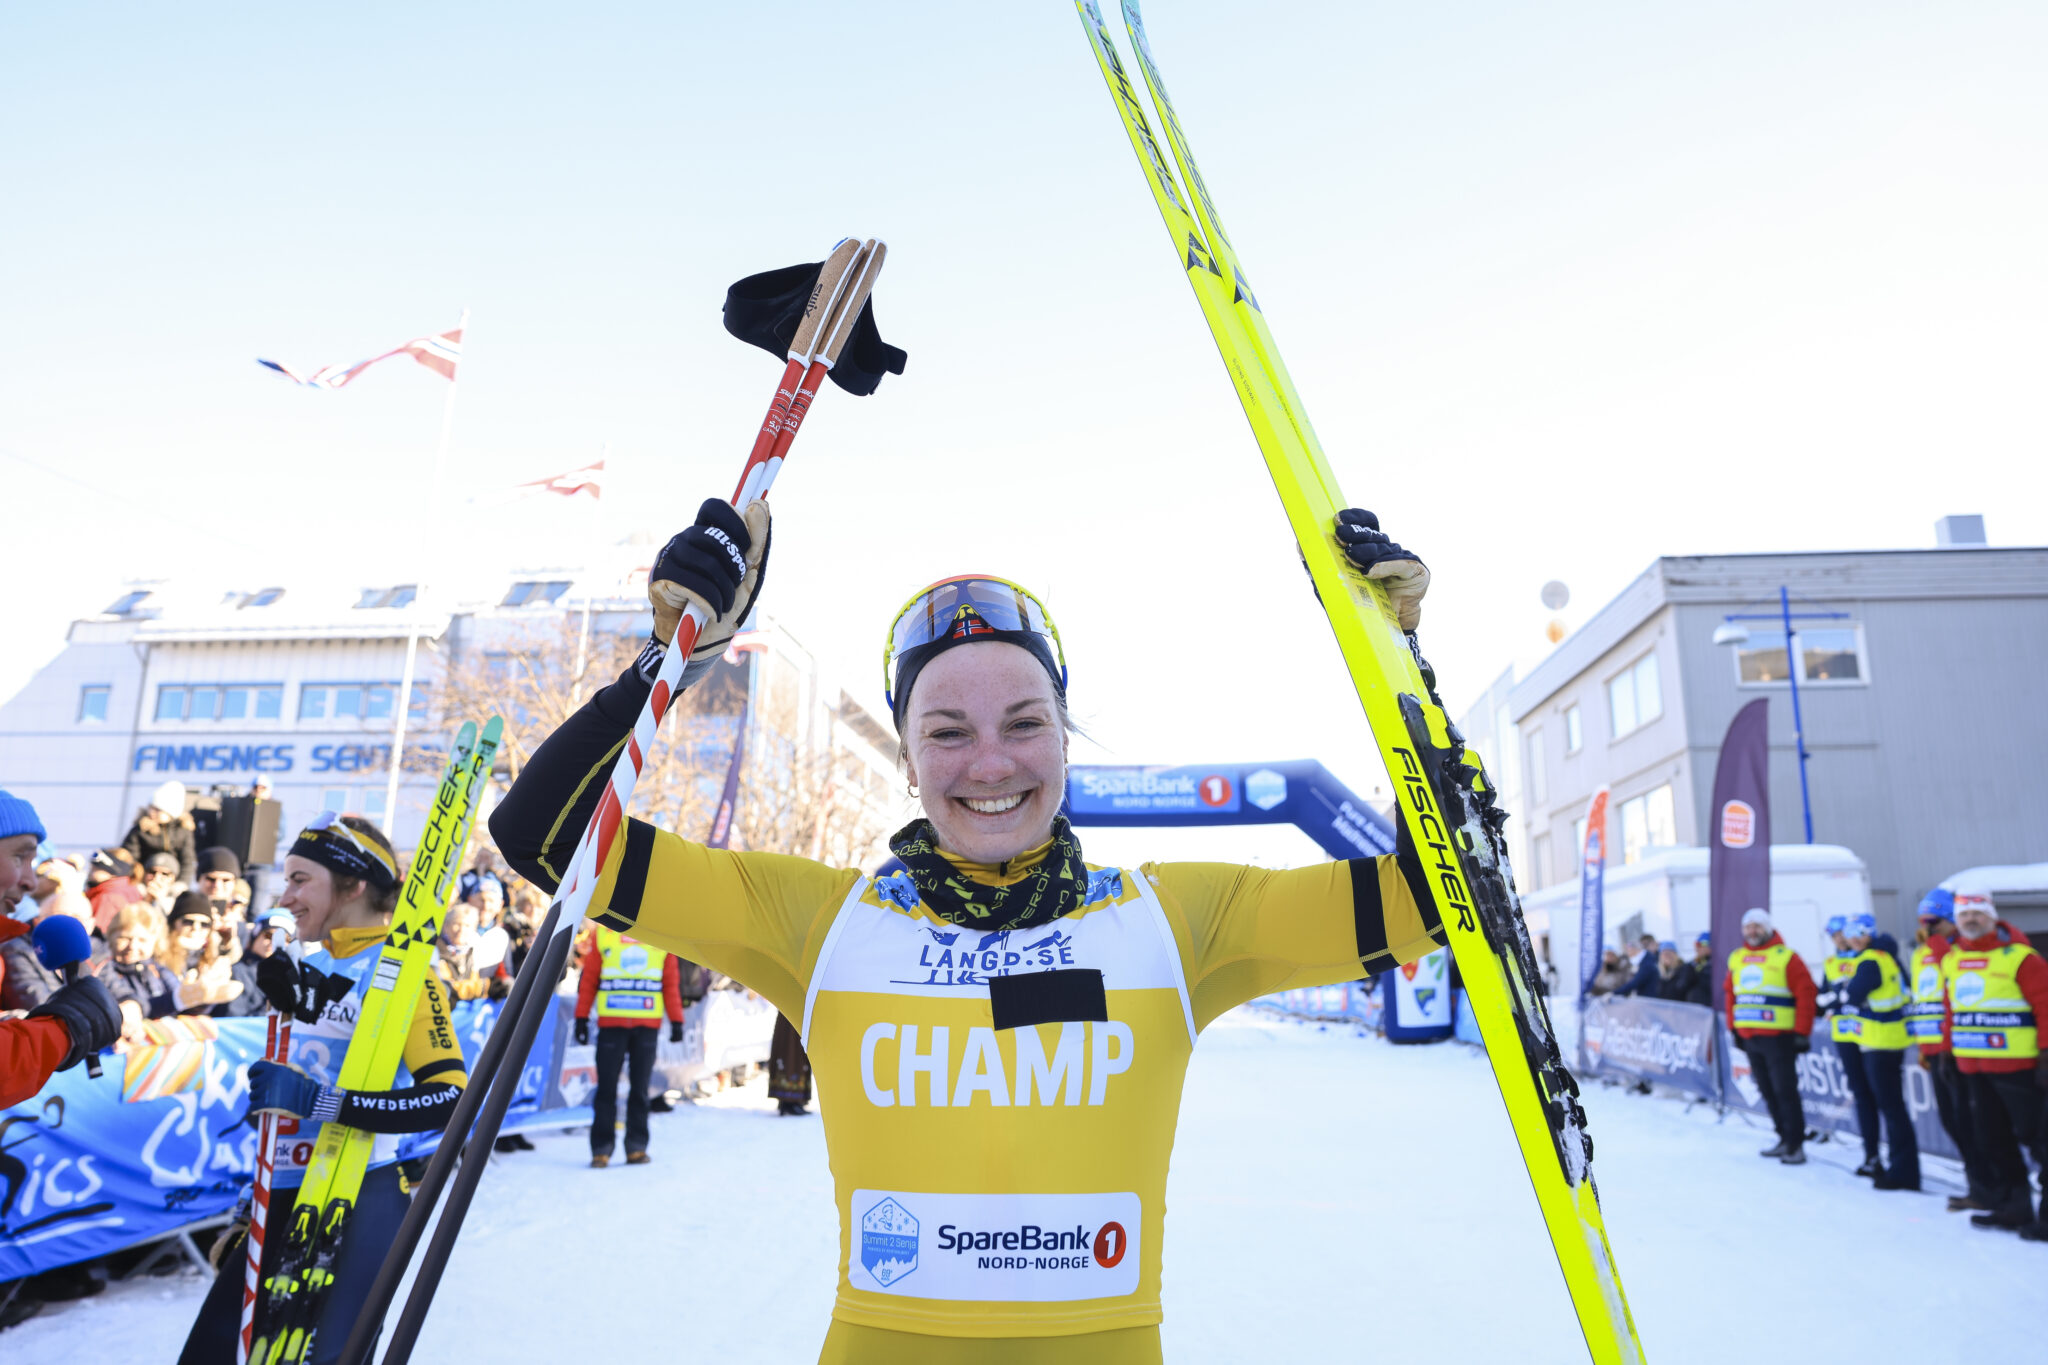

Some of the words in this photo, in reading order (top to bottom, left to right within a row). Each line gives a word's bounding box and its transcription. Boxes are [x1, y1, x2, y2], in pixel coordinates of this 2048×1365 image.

[133, 744, 294, 773] FINNSNES
[1081, 774, 1196, 799] SpareBank
[1392, 746, 1475, 933] FISCHER
[920, 944, 1075, 971] LANGD.SE
[424, 979, 453, 1050] engcon
[860, 1020, 1135, 1108] CHAMP
[352, 1085, 460, 1111] SWEDEMOUNT
[863, 1233, 888, 1247] Summit
[889, 1236, 895, 1247] 2
[896, 1237, 917, 1250] Senja
[937, 1224, 1091, 1255] SpareBank
[977, 1256, 1090, 1270] NORD-NORGE
